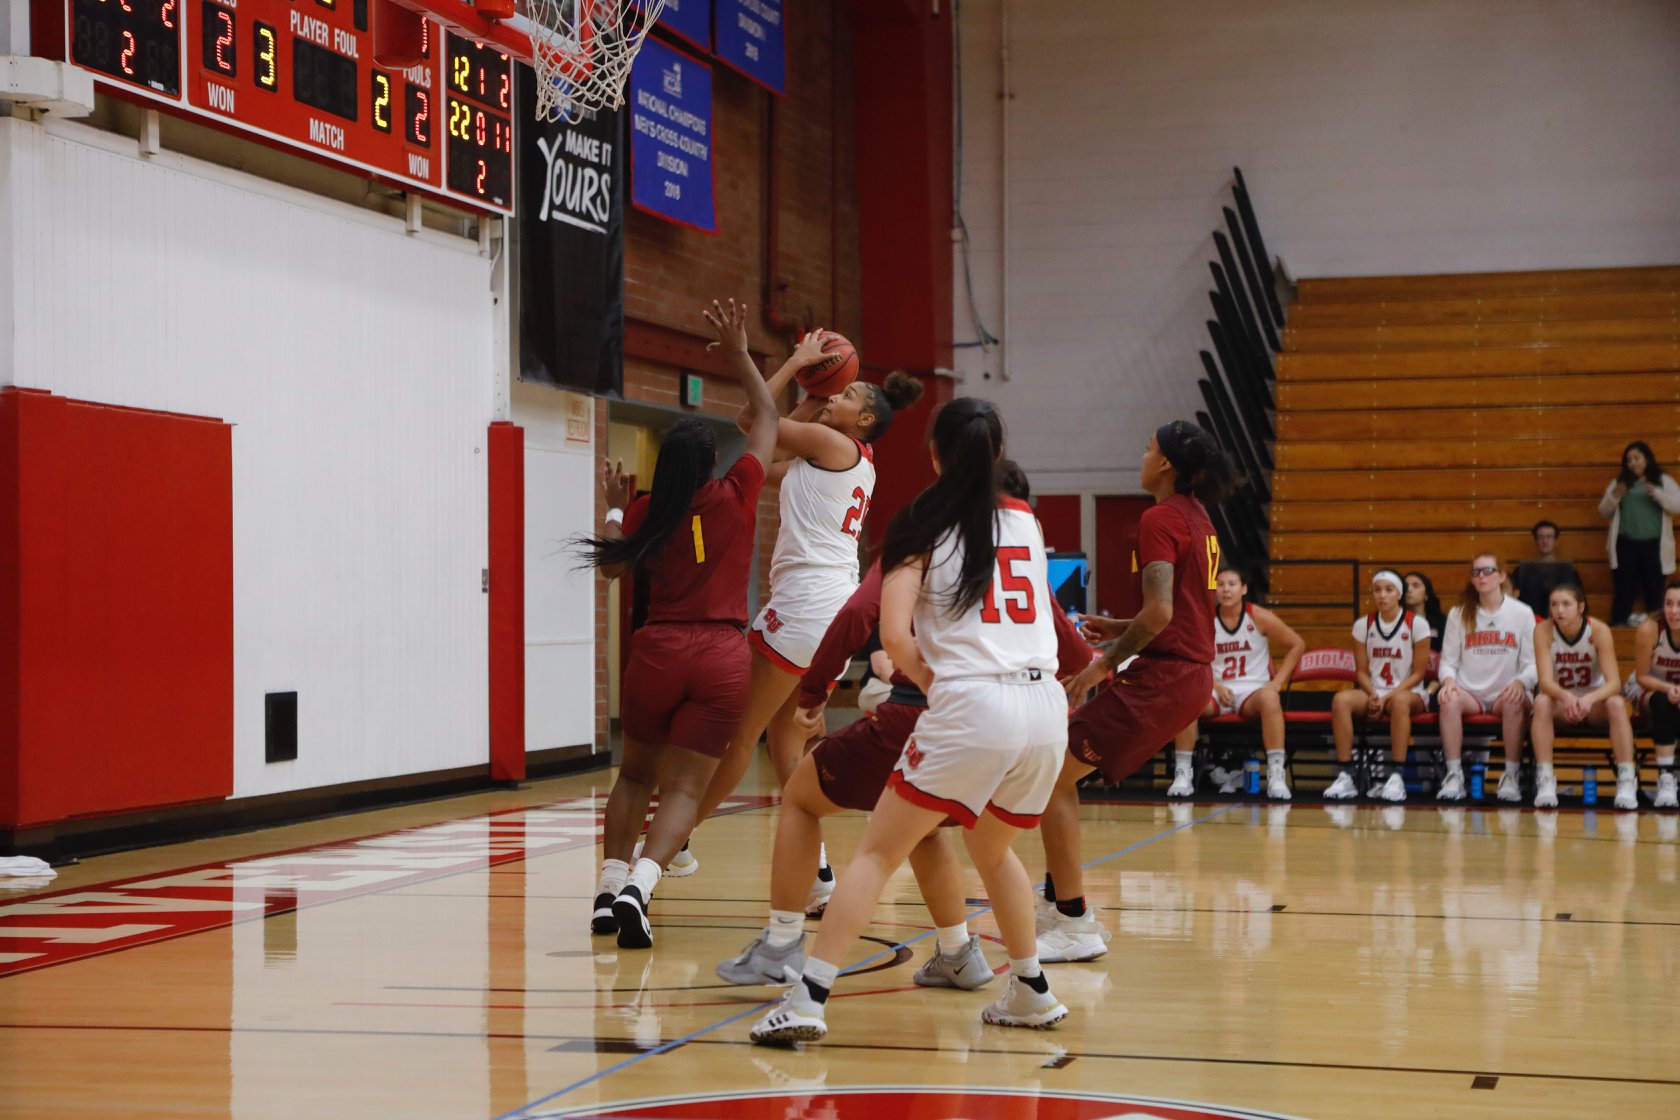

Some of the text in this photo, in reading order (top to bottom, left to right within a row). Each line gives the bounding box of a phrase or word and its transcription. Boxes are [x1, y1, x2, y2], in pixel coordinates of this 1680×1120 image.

[121, 30, 135, 75] 2
[216, 11, 233, 70] 2
[260, 28, 275, 85] 3
[290, 9, 359, 59] PLAYER FOUL
[207, 81, 235, 113] WON
[375, 75, 389, 128] 2
[454, 56, 509, 108] 12 1 2
[309, 118, 345, 151] MATCH
[415, 91, 428, 142] 2
[450, 100, 471, 140] 22
[408, 153, 430, 180] WON
[565, 128, 612, 167] MAKE IT
[476, 160, 486, 194] 2
[537, 132, 611, 223] YOURS
[691, 514, 706, 564] 1
[1206, 534, 1221, 591] 12
[980, 546, 1037, 625] 15
[1465, 630, 1518, 651] BIOLA
[1222, 655, 1247, 681] 21
[1379, 661, 1394, 686] 4
[1558, 665, 1593, 690] 23
